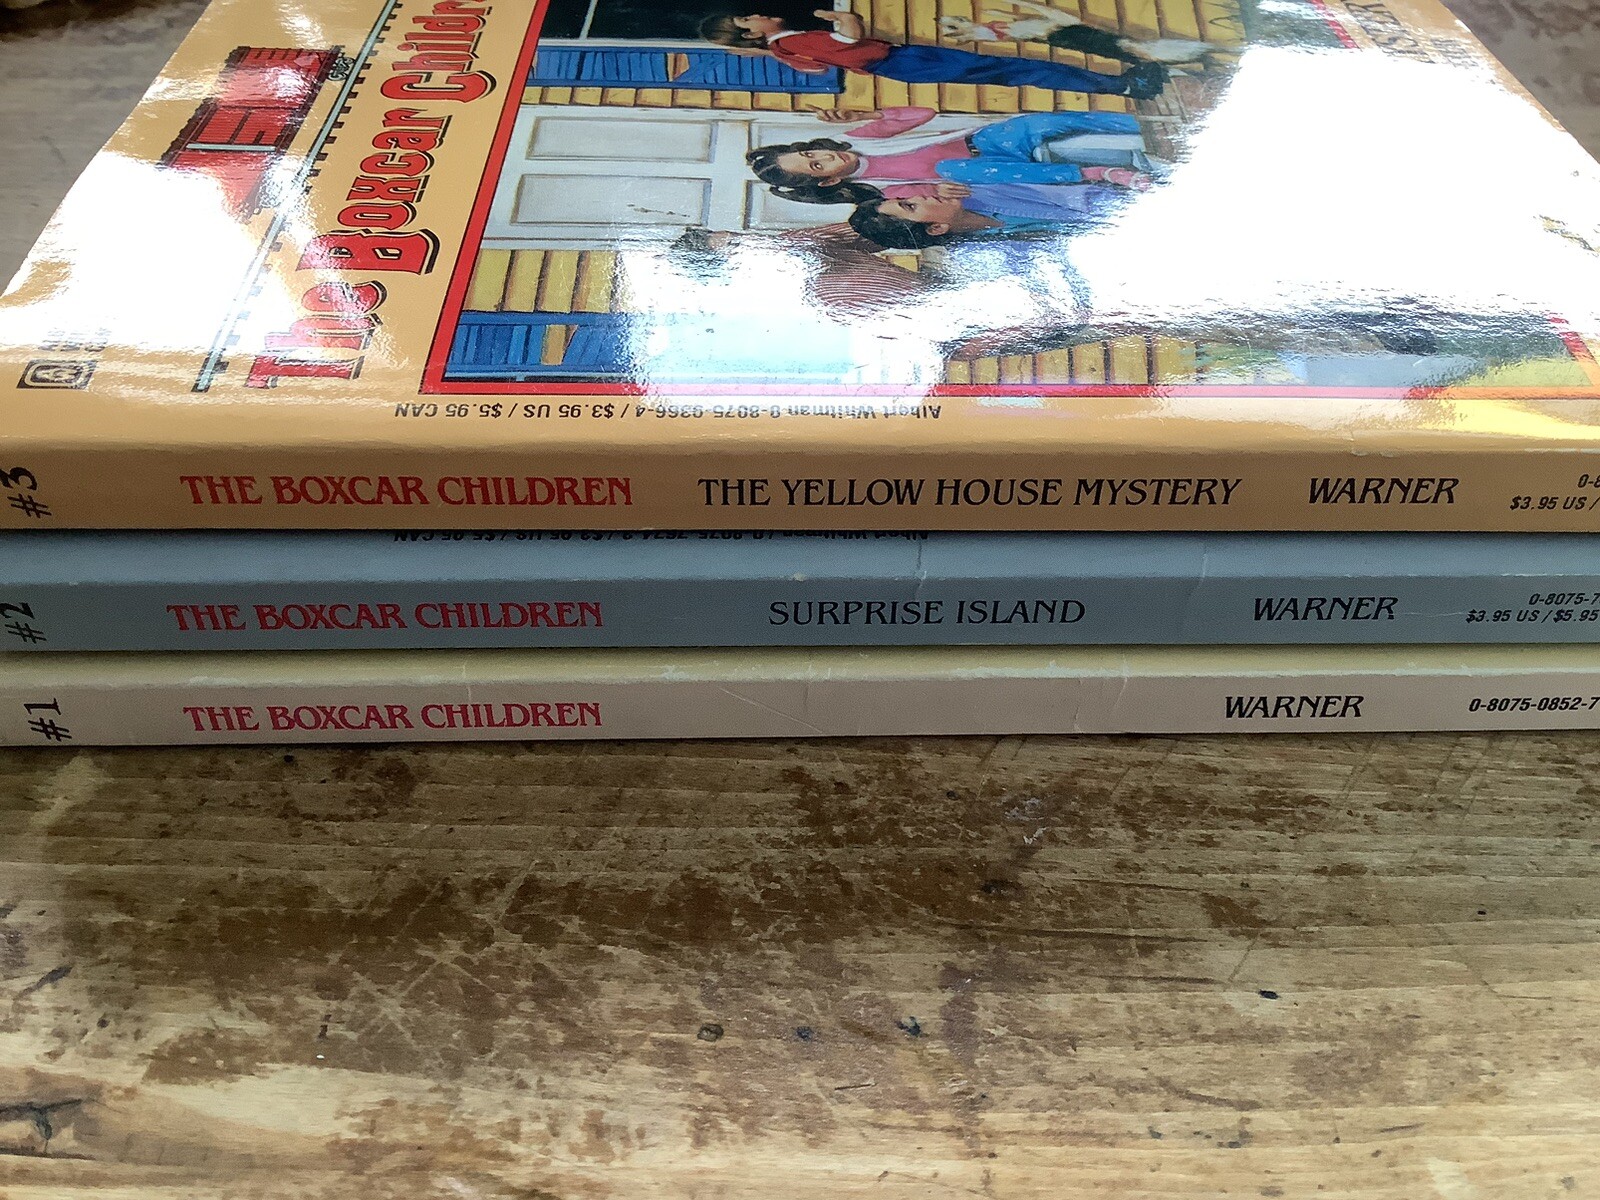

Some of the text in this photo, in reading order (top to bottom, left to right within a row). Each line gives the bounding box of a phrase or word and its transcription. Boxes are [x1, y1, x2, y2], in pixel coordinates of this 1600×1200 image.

[243, 0, 498, 389] The Boxcar Childr
[394, 402, 438, 419] CAN
[445, 402, 503, 420] $5.95
[507, 403, 519, 419] /
[523, 403, 551, 419] US
[558, 402, 615, 420] $3.95
[620, 403, 631, 419] /
[787, 403, 878, 420] Whitman
[881, 403, 942, 420] Albert
[0, 466, 633, 519] #3 THE BOXCAR CHILDREN
[698, 477, 1242, 506] THE YELLOW HOUSE MYSTERY
[1309, 477, 1459, 505] WARNER
[1509, 494, 1559, 511] $3.95
[1562, 496, 1588, 510] US
[1528, 593, 1600, 606] 0-8075-7
[769, 599, 1086, 625] SURPRISE ISLAND
[1253, 597, 1399, 622] WARNER
[1466, 609, 1512, 624] $3.95
[1516, 609, 1540, 623] US
[0, 601, 603, 644] #2 THE BOXCAR CHILDREN
[1224, 695, 1365, 720] WARNER
[1469, 696, 1600, 712] 0-8075-0852-7
[23, 697, 603, 743] #1 THE BOXCAR CHILDREN
